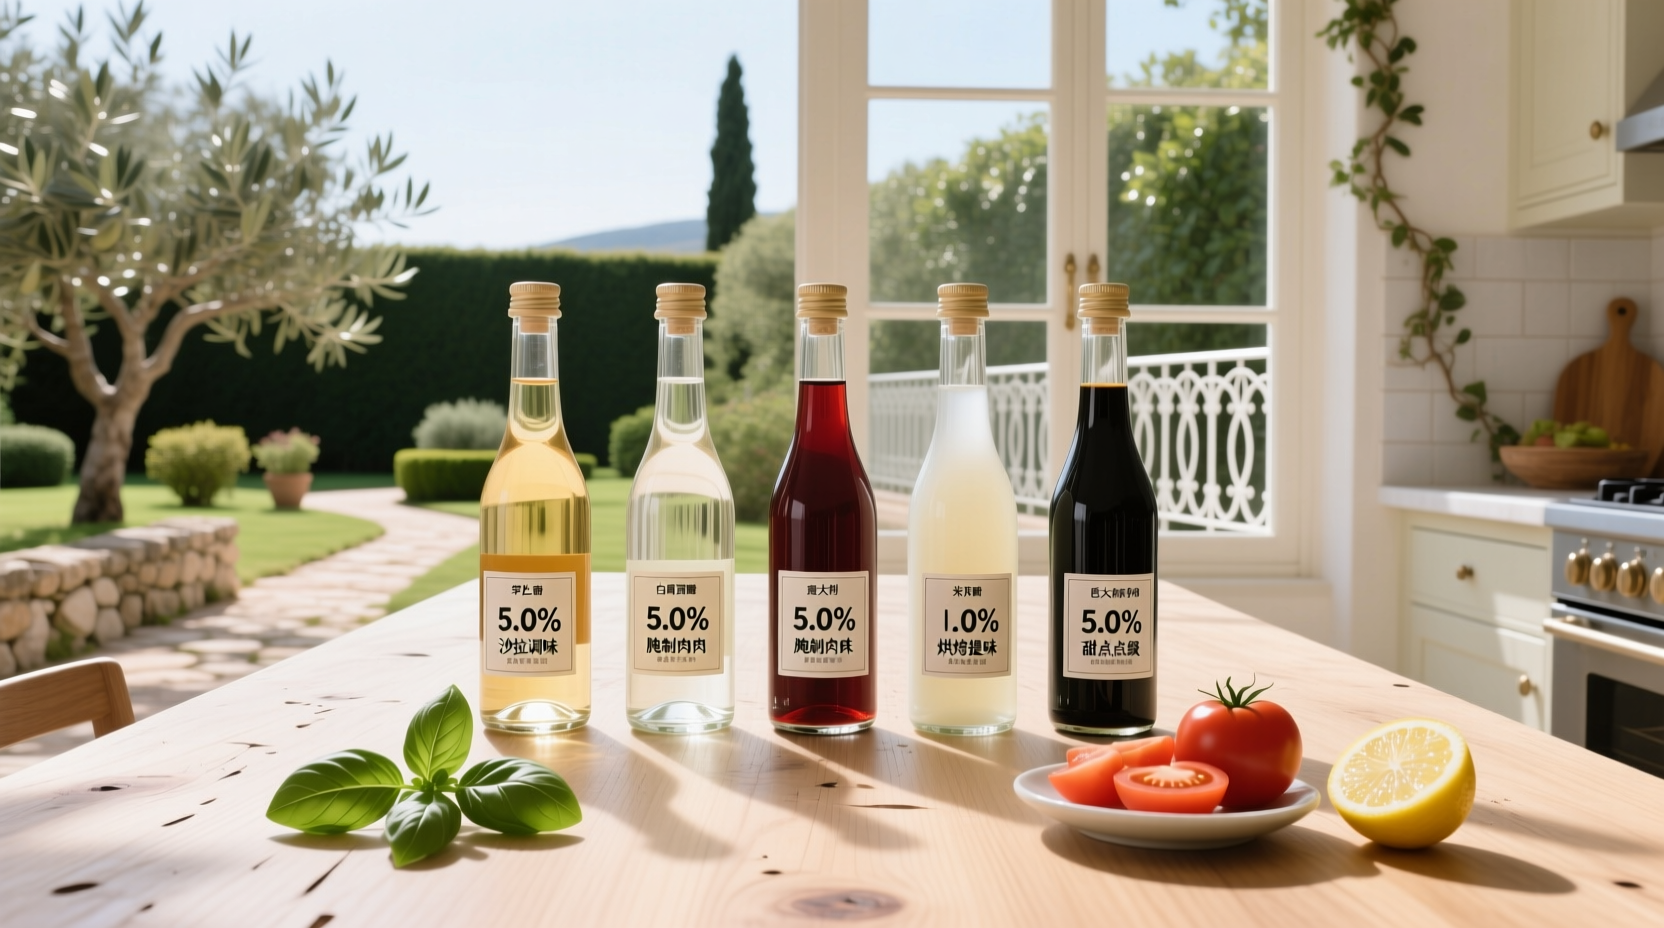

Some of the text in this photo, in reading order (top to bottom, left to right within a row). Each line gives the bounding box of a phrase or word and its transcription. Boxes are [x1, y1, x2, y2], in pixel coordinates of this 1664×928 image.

[498, 606, 561, 633] 5.0%
[646, 606, 709, 631] 5.0%
[793, 606, 856, 632] 5.0%
[944, 608, 999, 633] 1.0%
[1081, 609, 1142, 634] 5.0%
